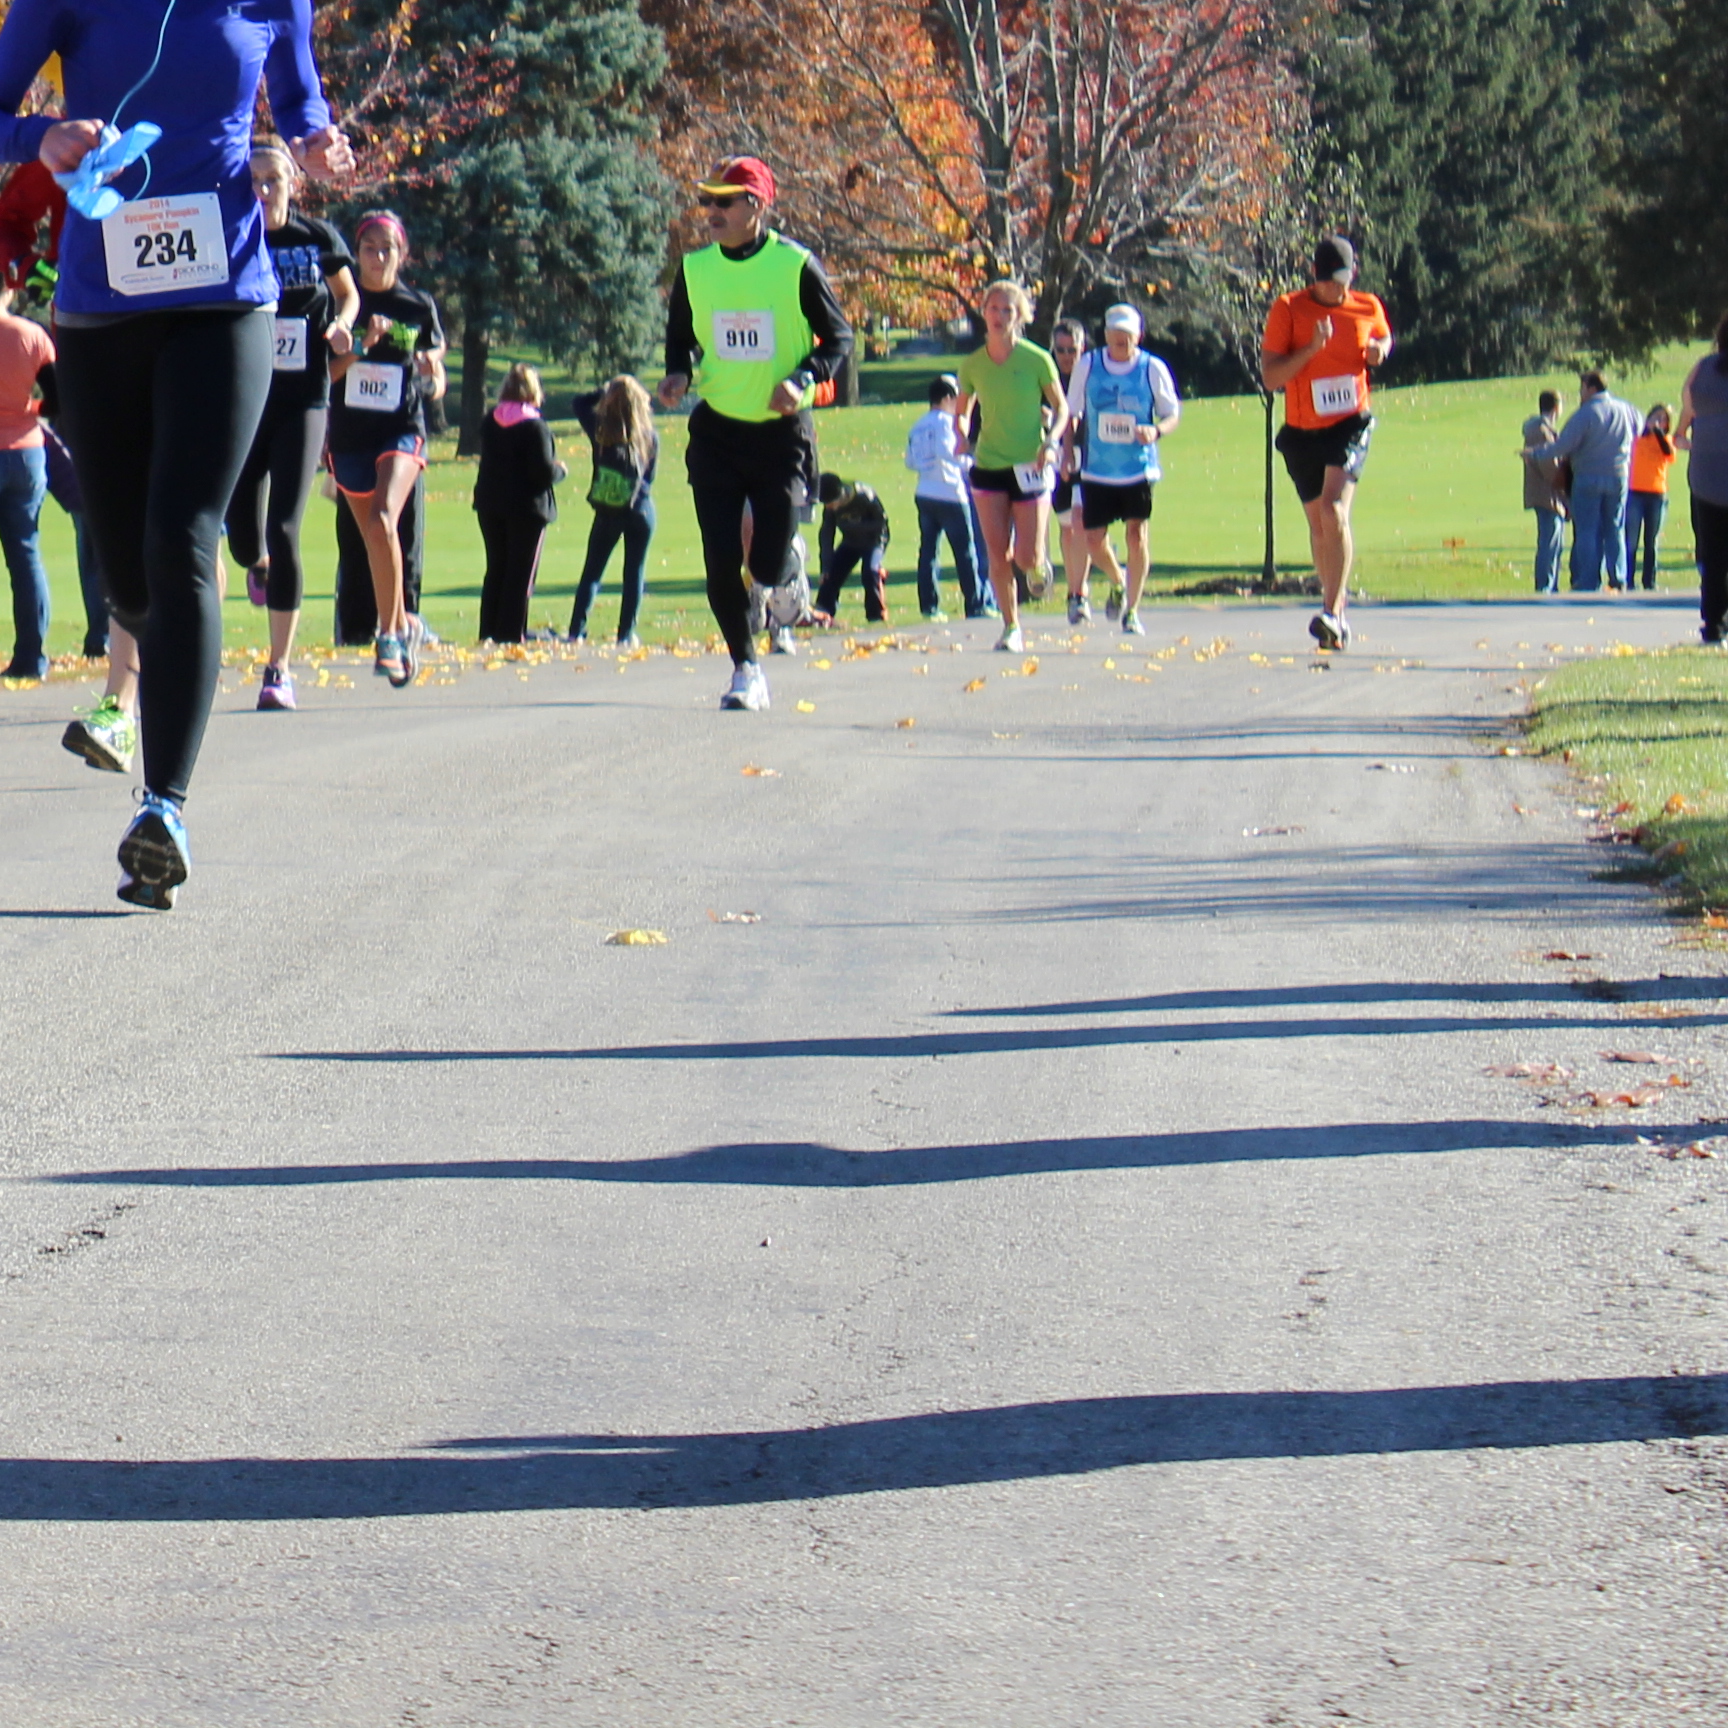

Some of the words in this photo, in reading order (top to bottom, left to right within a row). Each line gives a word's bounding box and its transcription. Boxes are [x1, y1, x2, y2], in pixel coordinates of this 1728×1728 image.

[134, 229, 197, 268] 234
[277, 338, 297, 356] 27
[727, 329, 758, 348] 910
[360, 381, 388, 397] 902
